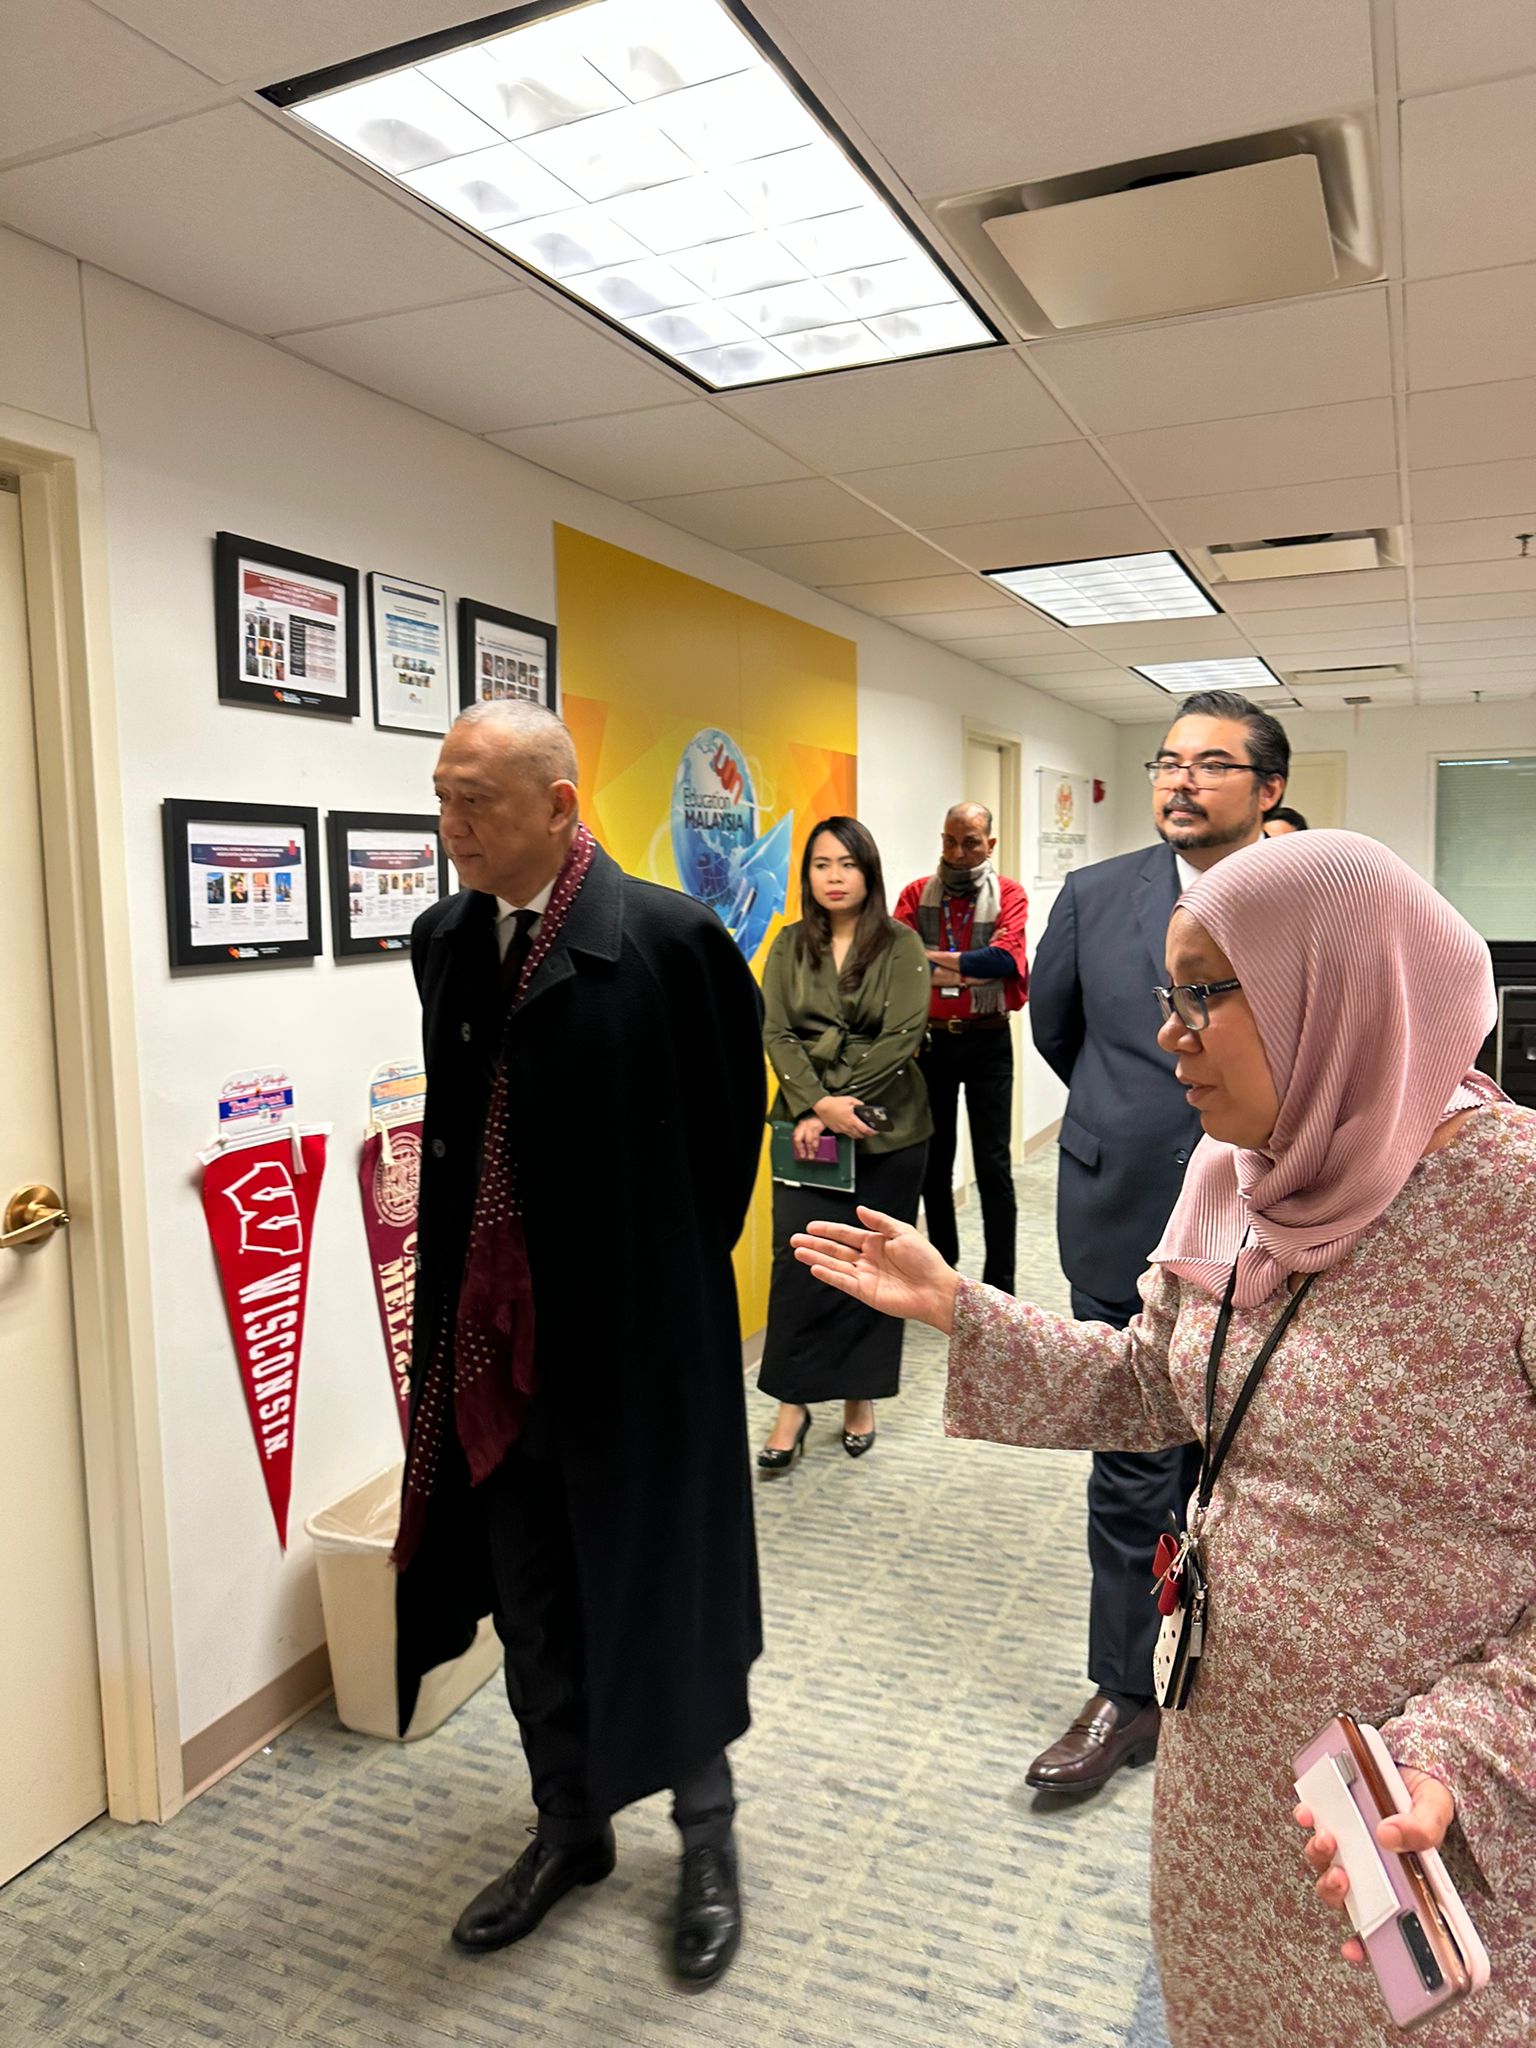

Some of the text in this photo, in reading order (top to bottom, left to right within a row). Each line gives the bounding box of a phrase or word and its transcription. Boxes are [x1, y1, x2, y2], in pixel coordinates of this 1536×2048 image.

[684, 787, 731, 809] Education
[685, 810, 744, 831] MALAYSIA
[239, 1262, 301, 1455] WISCONSIN
